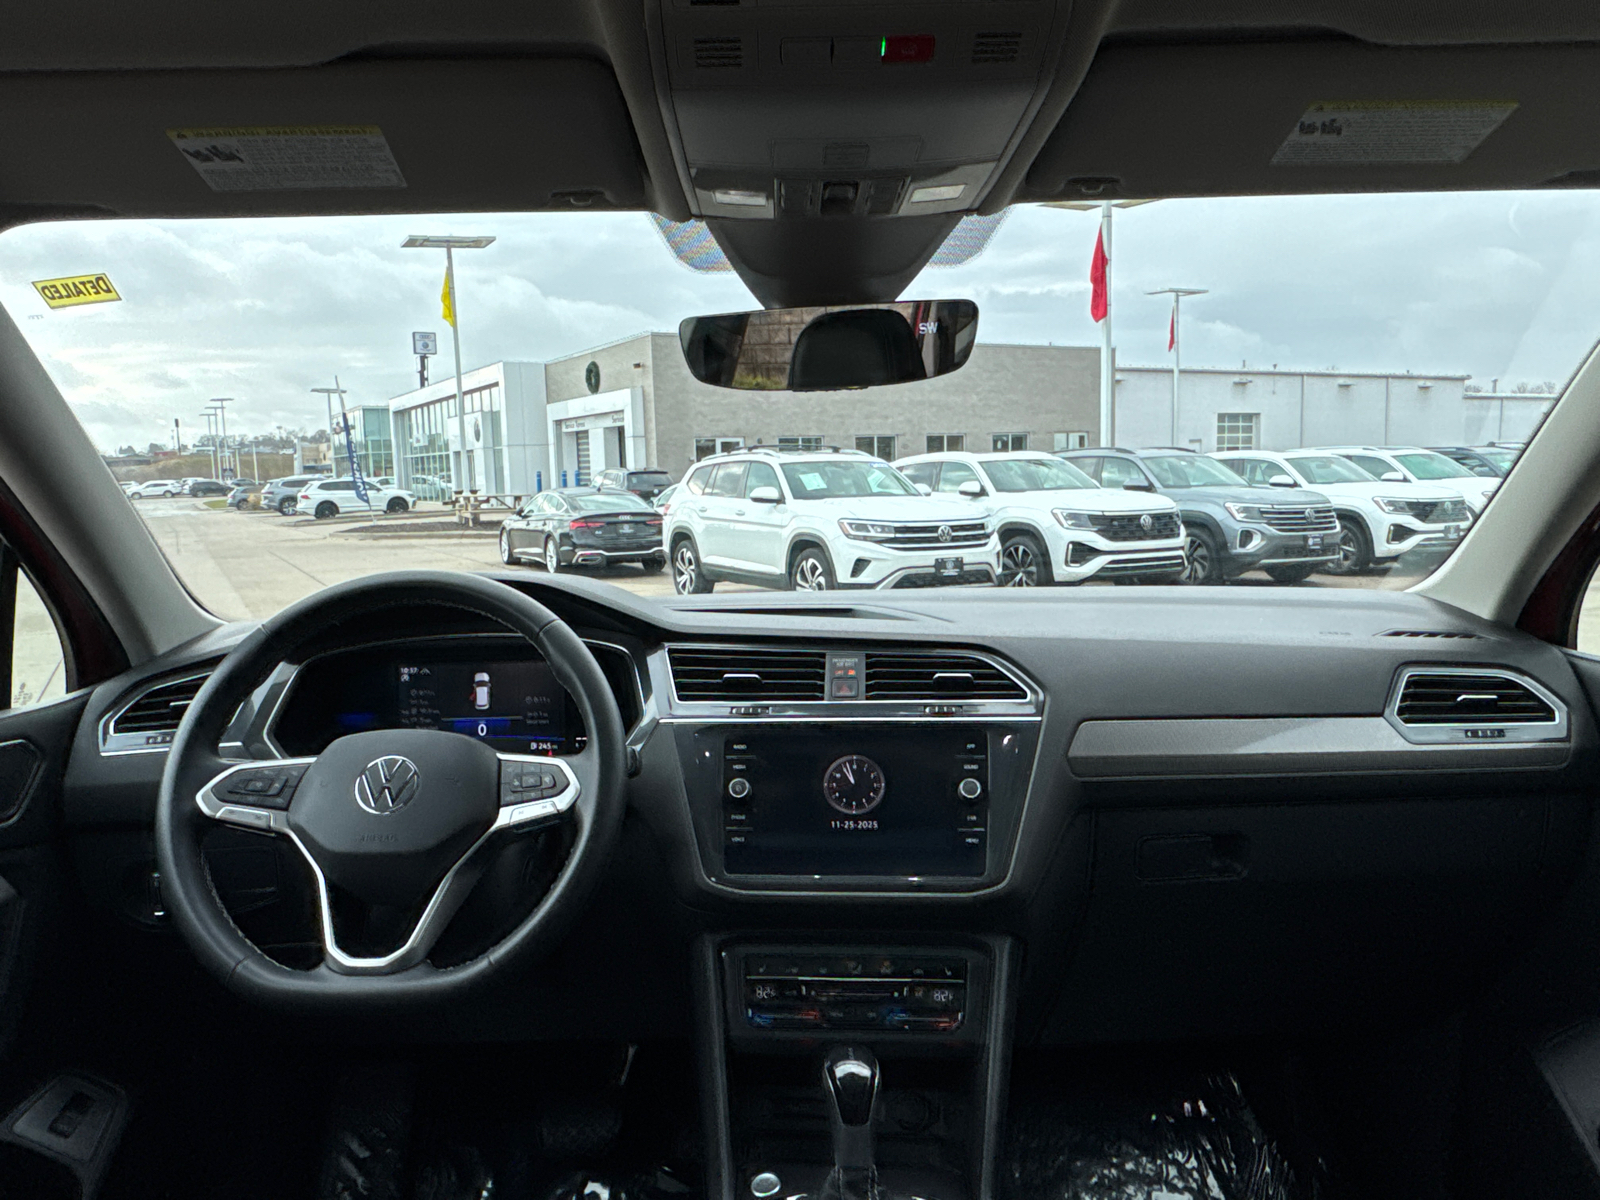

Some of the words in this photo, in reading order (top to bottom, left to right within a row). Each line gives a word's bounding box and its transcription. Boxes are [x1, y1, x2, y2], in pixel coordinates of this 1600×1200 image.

[918, 321, 938, 335] SW
[477, 723, 487, 737] 0
[830, 820, 879, 829] 11-25-2025
